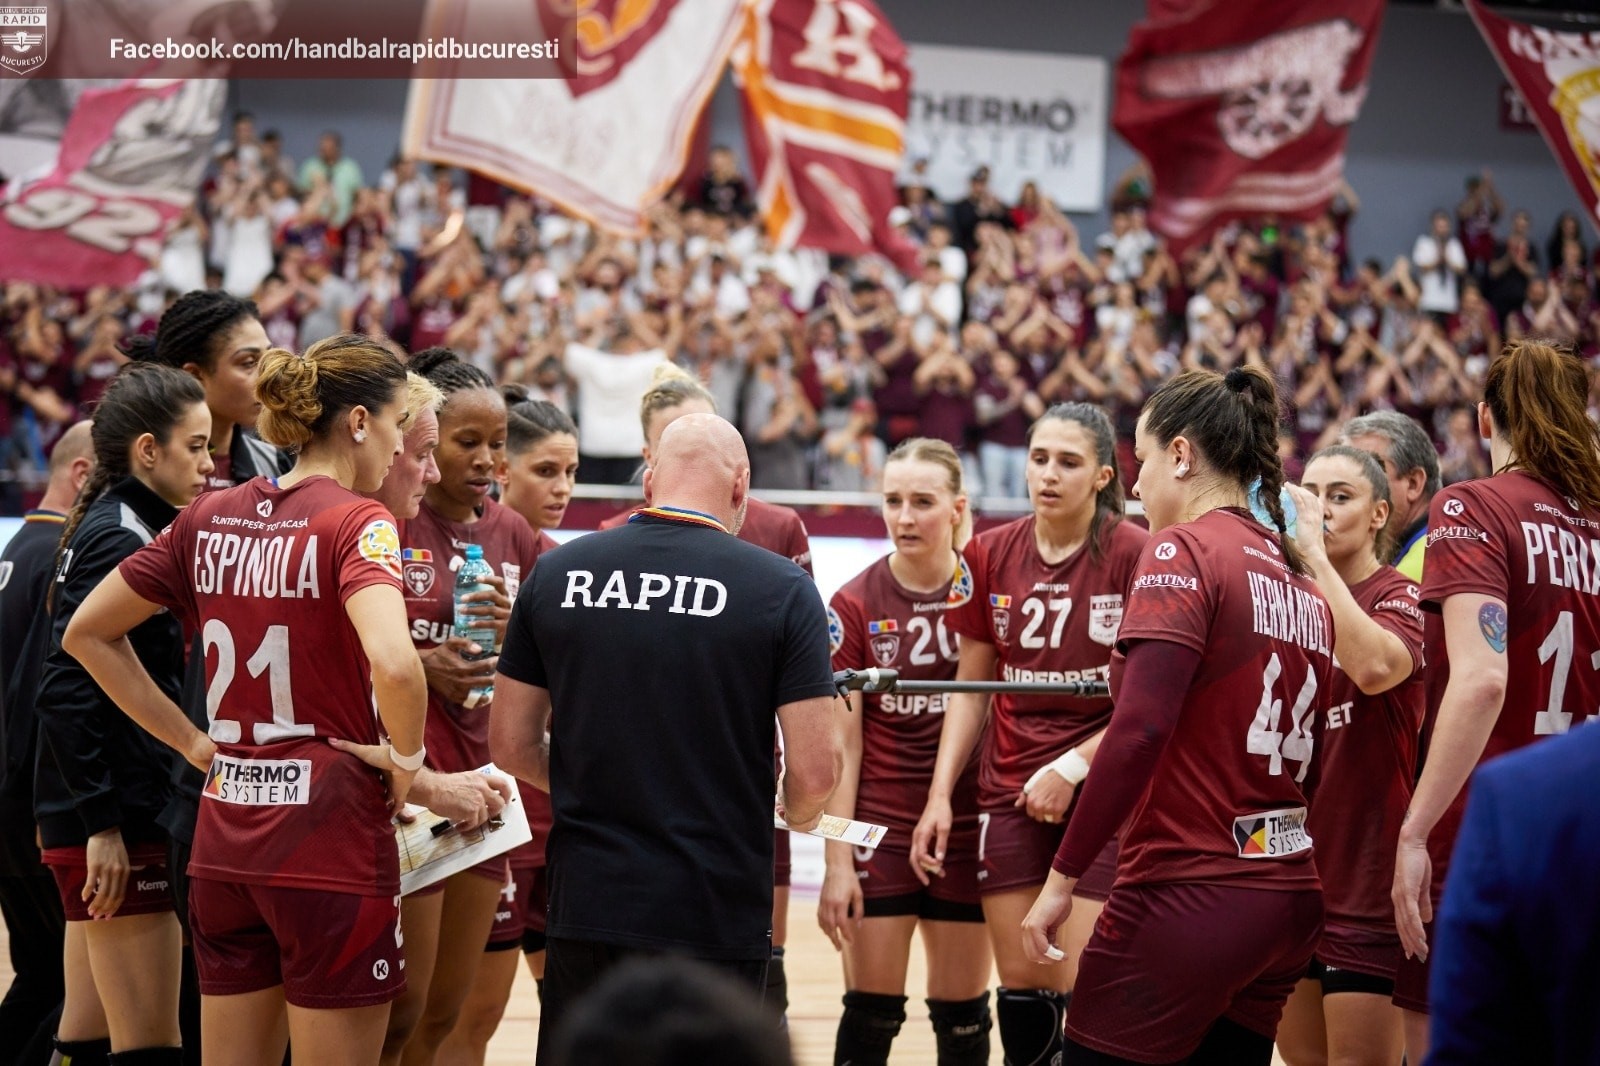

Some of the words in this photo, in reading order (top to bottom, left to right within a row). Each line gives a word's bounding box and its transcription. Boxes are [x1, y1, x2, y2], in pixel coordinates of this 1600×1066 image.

[211, 515, 242, 527] SUNTEM
[195, 530, 320, 599] ESPINOLA
[410, 572, 428, 581] 100
[561, 570, 728, 617] RAPID
[1020, 597, 1072, 648] 27
[202, 618, 316, 746] 21
[1534, 610, 1600, 735] 1
[1247, 652, 1318, 783] 44
[220, 782, 299, 803] SYSTEM
[224, 761, 301, 785] THERMO
[137, 880, 168, 892] Kemp
